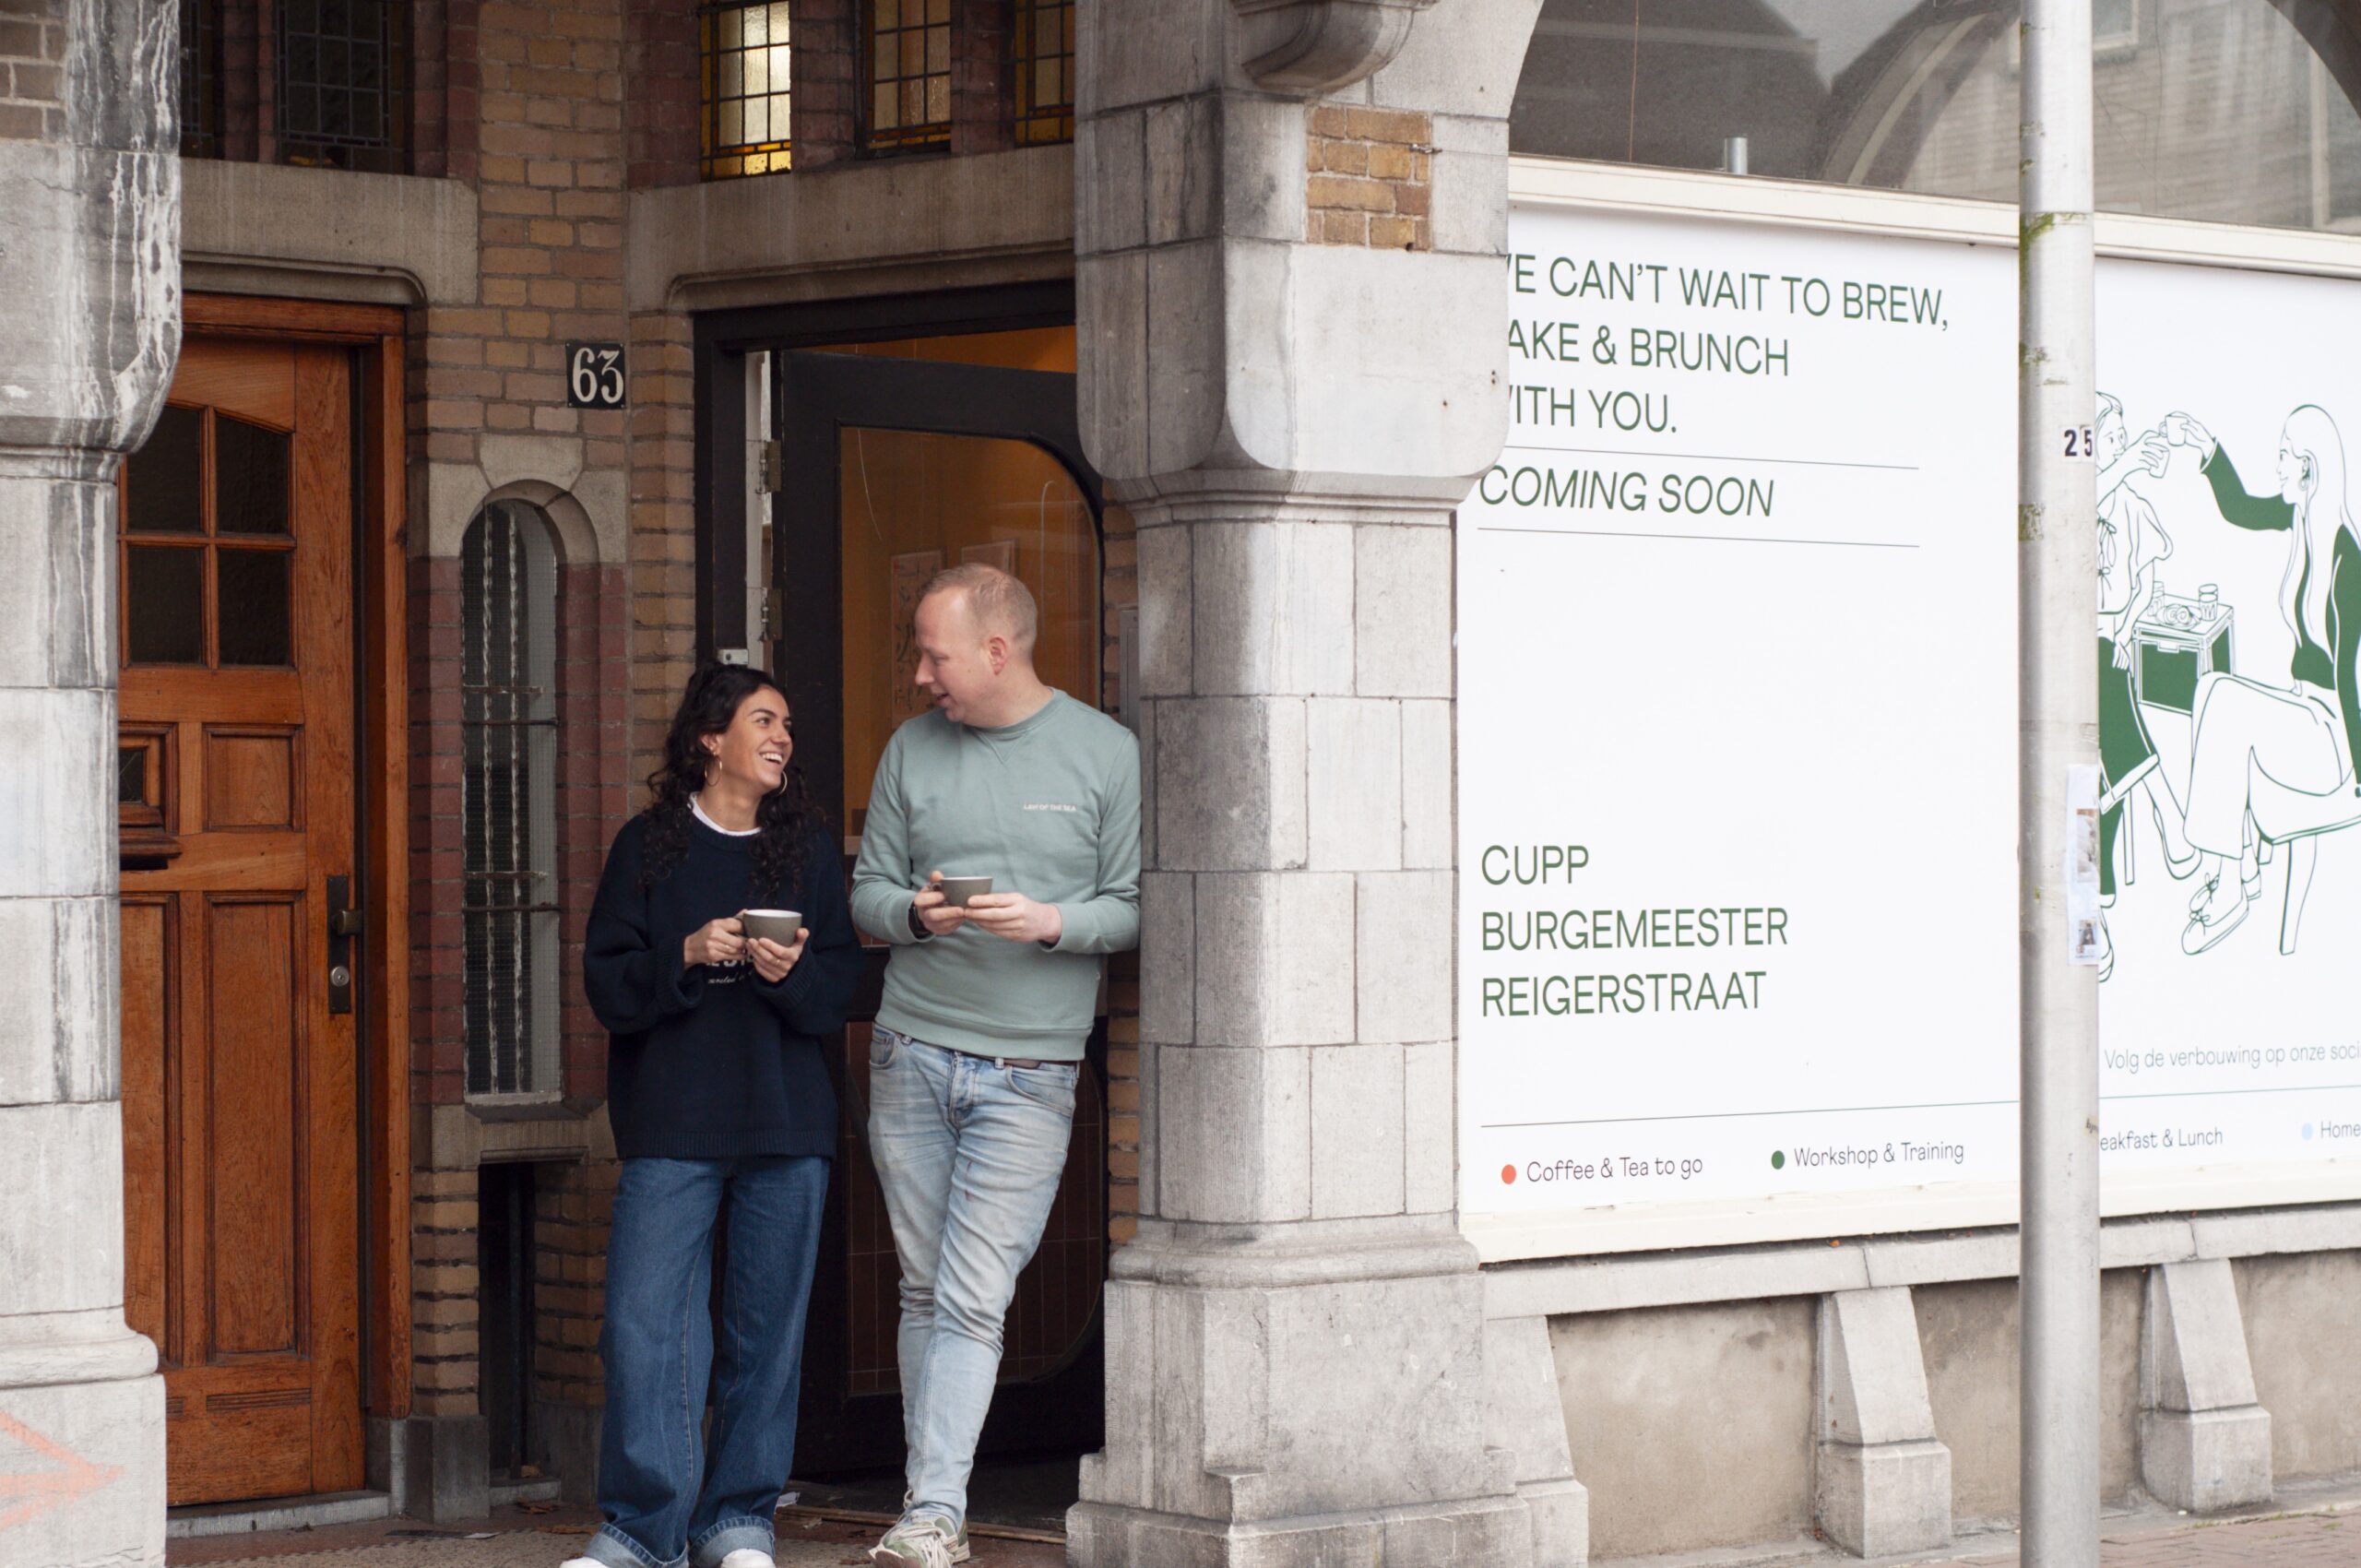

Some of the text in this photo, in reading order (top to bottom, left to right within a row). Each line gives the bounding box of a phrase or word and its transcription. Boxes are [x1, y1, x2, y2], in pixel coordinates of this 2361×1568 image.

[1507, 253, 1948, 331] E CAN’T WAIT TO BREW,
[1508, 319, 1788, 376] AKE & BRUNCH
[572, 347, 624, 403] 63
[1509, 384, 1677, 433] ITH YOU.
[2064, 429, 2093, 457] 25
[1479, 465, 1774, 517] COMING SOON
[1482, 845, 1589, 885] CUPP
[1483, 908, 1787, 951] BURGEMEESTER
[1483, 971, 1766, 1017] REIGERSTRAAT
[2105, 1039, 2361, 1075] Volg de verbouwing op onze soci
[1794, 1141, 1964, 1169] Workshop & Training
[2100, 1126, 2224, 1152] eakfast & Lunch
[1527, 1157, 1703, 1182] Coffee & Tea to go
